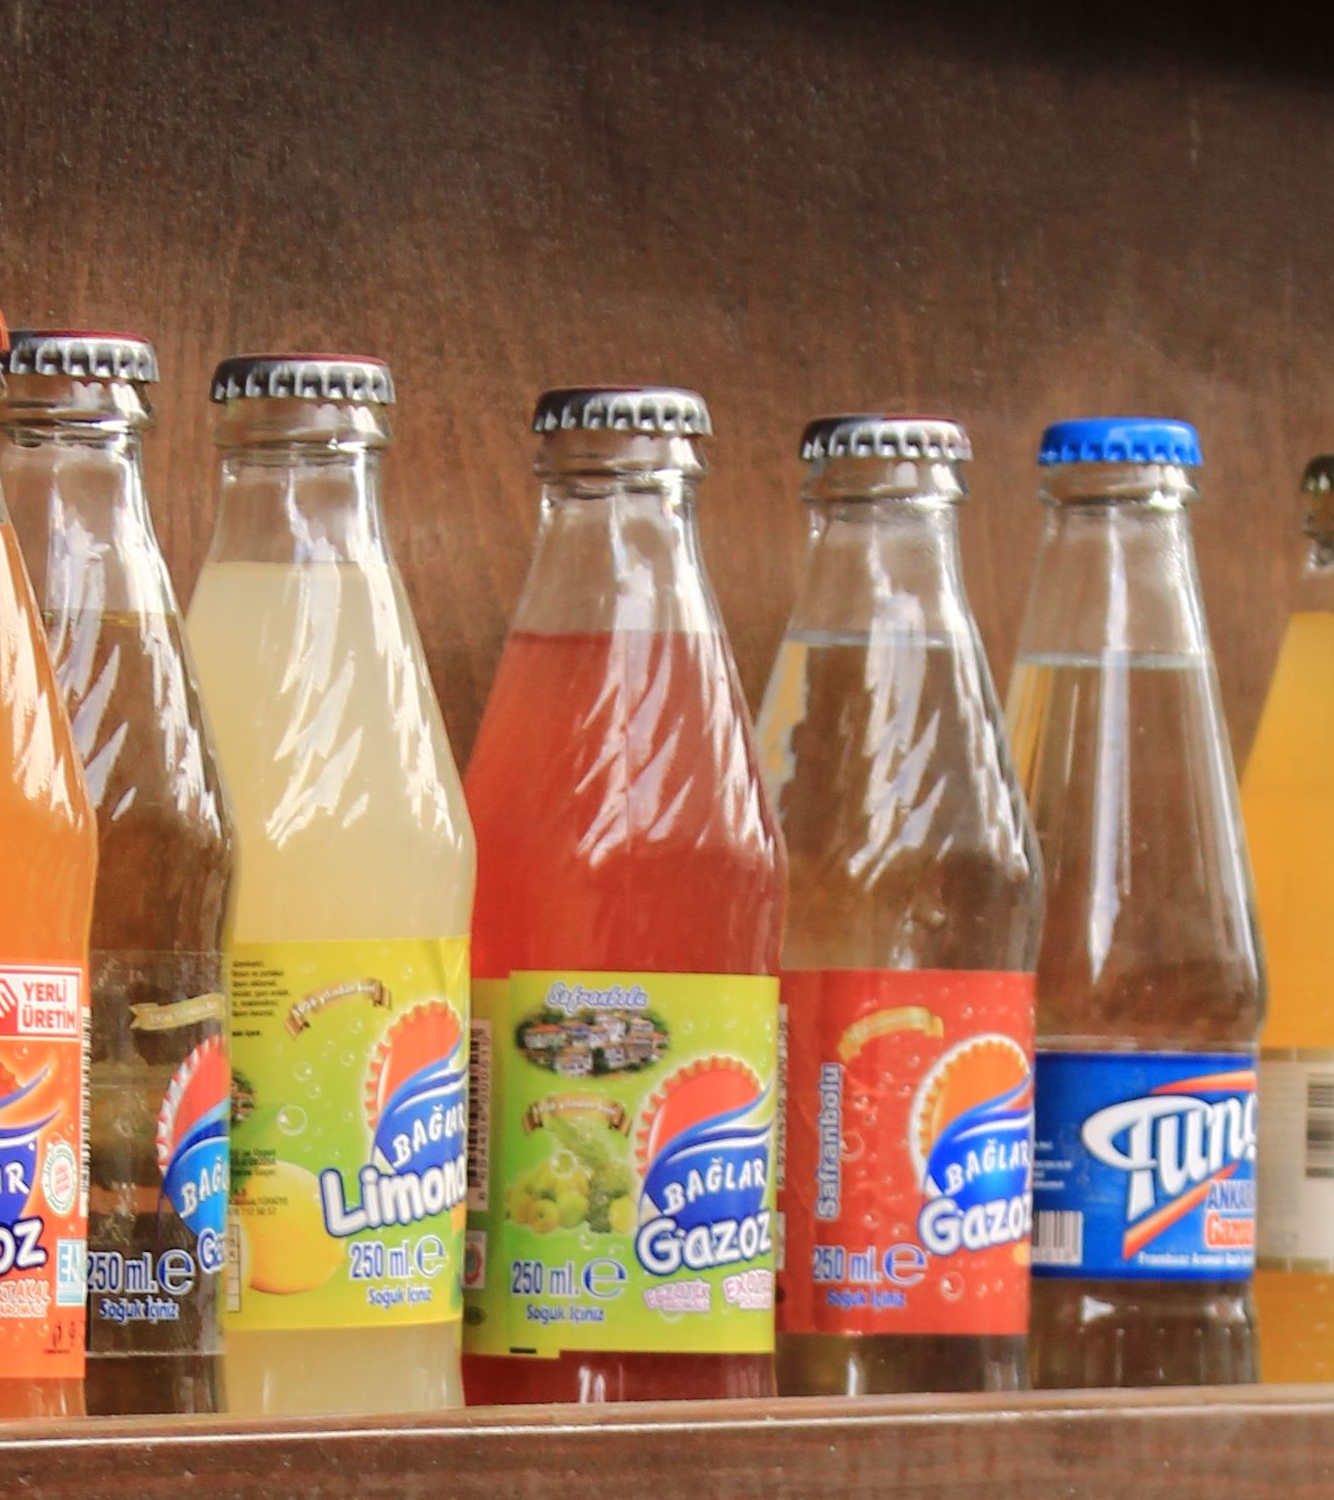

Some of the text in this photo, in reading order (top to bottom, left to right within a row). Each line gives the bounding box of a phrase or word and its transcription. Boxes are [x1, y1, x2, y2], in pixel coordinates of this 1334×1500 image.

[22, 979, 68, 1003] YERLİ
[21, 1003, 77, 1030] ÜRETİM
[816, 1063, 844, 1221] Safranbolu
[662, 1155, 767, 1215] BAĞLAR
[348, 1242, 385, 1279] 250
[635, 1208, 773, 1277] Gazoz
[510, 1259, 544, 1295] 250
[812, 1245, 845, 1281] 250
